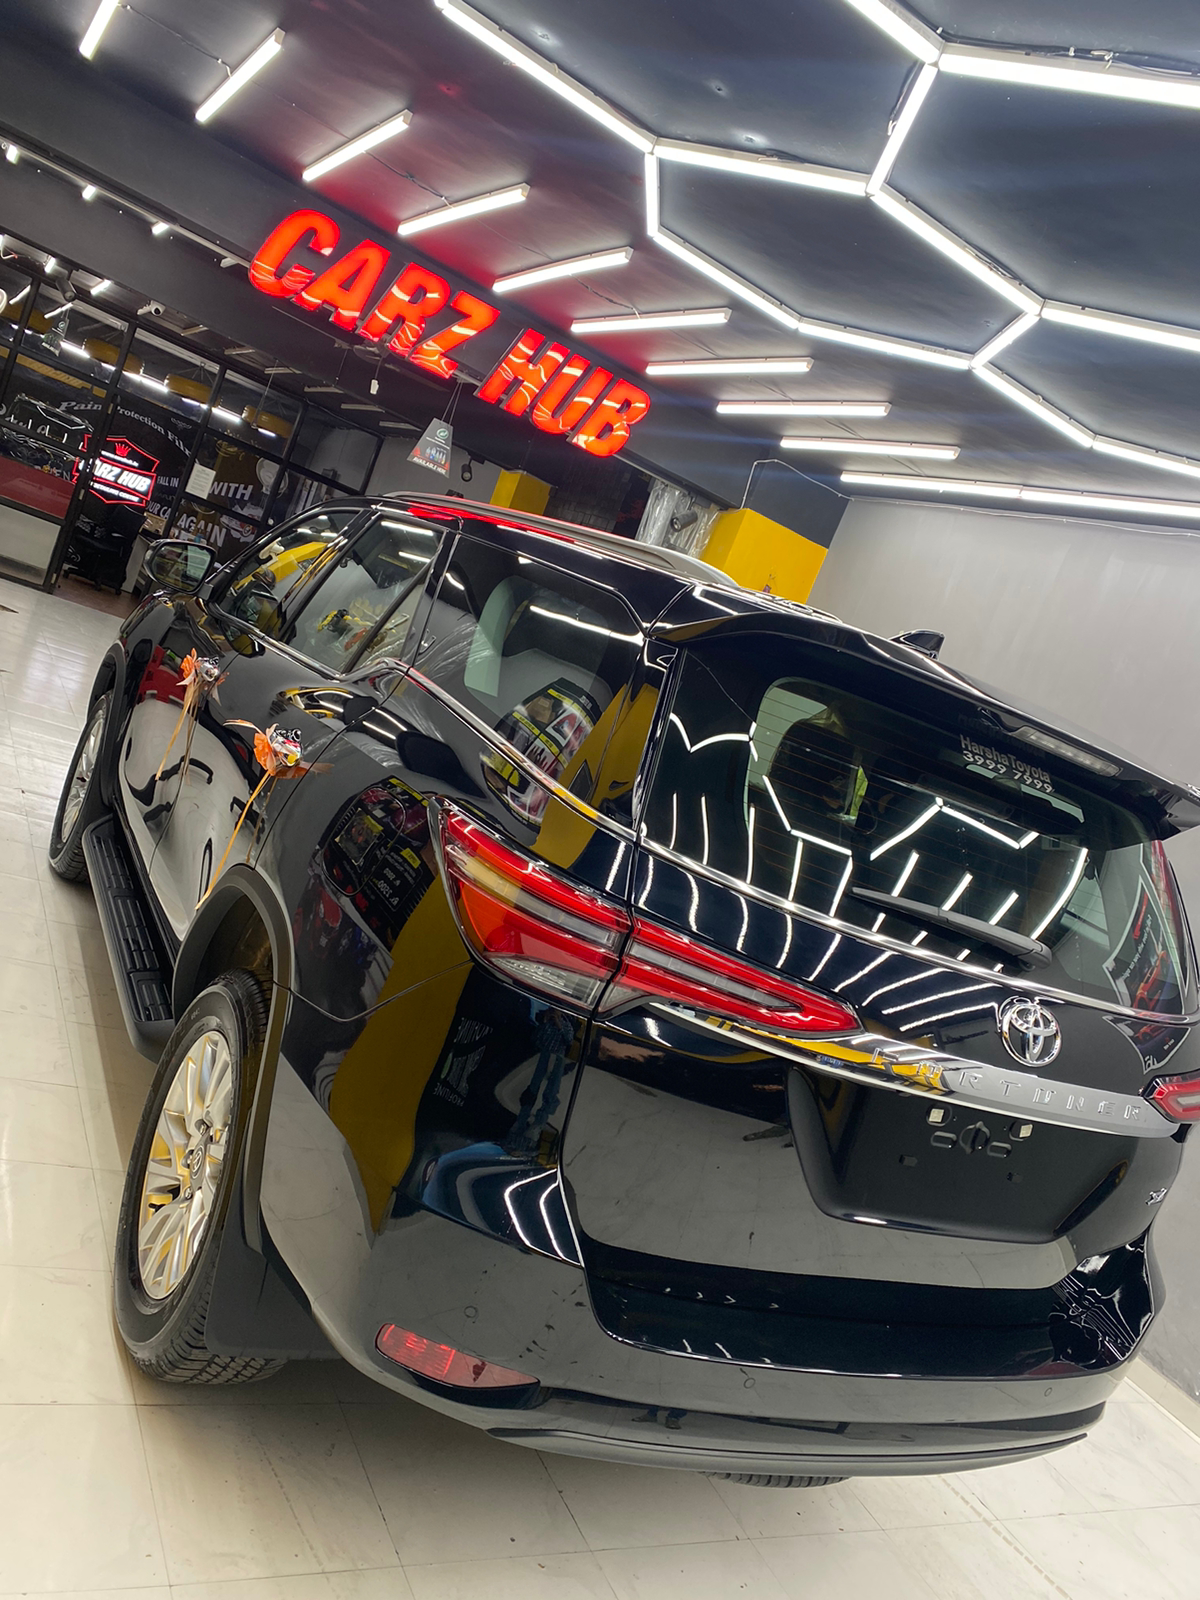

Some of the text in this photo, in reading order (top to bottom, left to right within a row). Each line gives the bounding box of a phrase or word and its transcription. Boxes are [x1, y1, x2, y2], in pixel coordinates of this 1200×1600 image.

[249, 208, 651, 457] CARZ HUB
[60, 401, 102, 411] Pain
[117, 470, 152, 493] HUB
[157, 475, 254, 500] FALL IN WITH
[146, 500, 227, 547] OUR CA AGAIN
[963, 750, 1053, 794] 3999 7999
